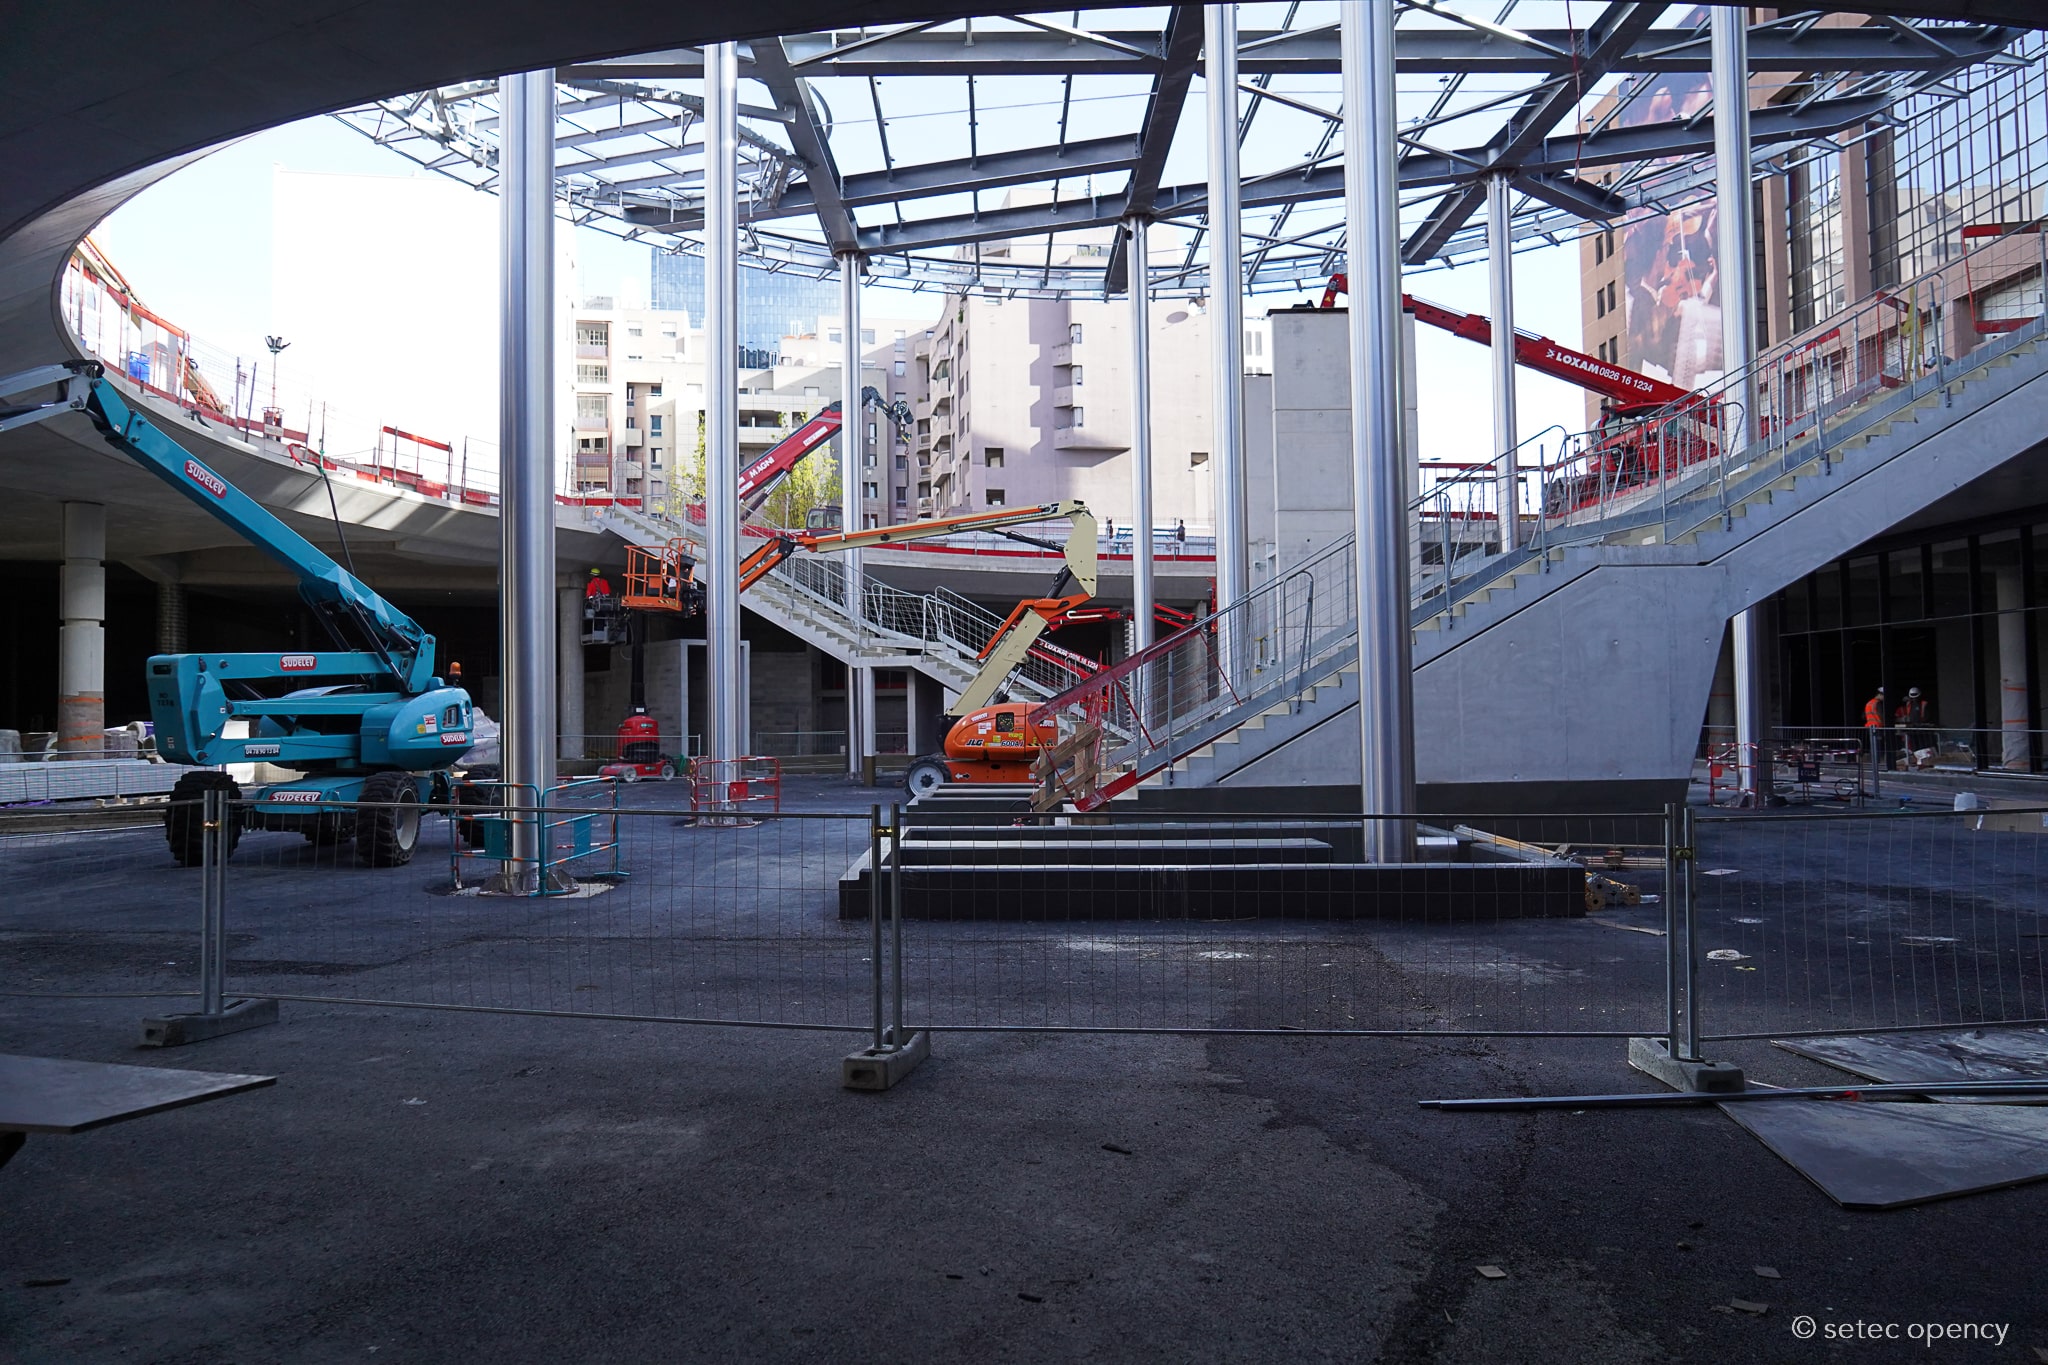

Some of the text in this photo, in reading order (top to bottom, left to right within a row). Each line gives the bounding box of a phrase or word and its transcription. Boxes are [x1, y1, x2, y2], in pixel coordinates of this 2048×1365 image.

[1556, 352, 1653, 392] LOXAM 0826 16 1234
[749, 456, 775, 478] MAGNI
[187, 463, 224, 494] SUDELEV
[283, 658, 314, 667] SUDELEV
[966, 739, 984, 747] JLG
[272, 793, 319, 802] SUDELEV
